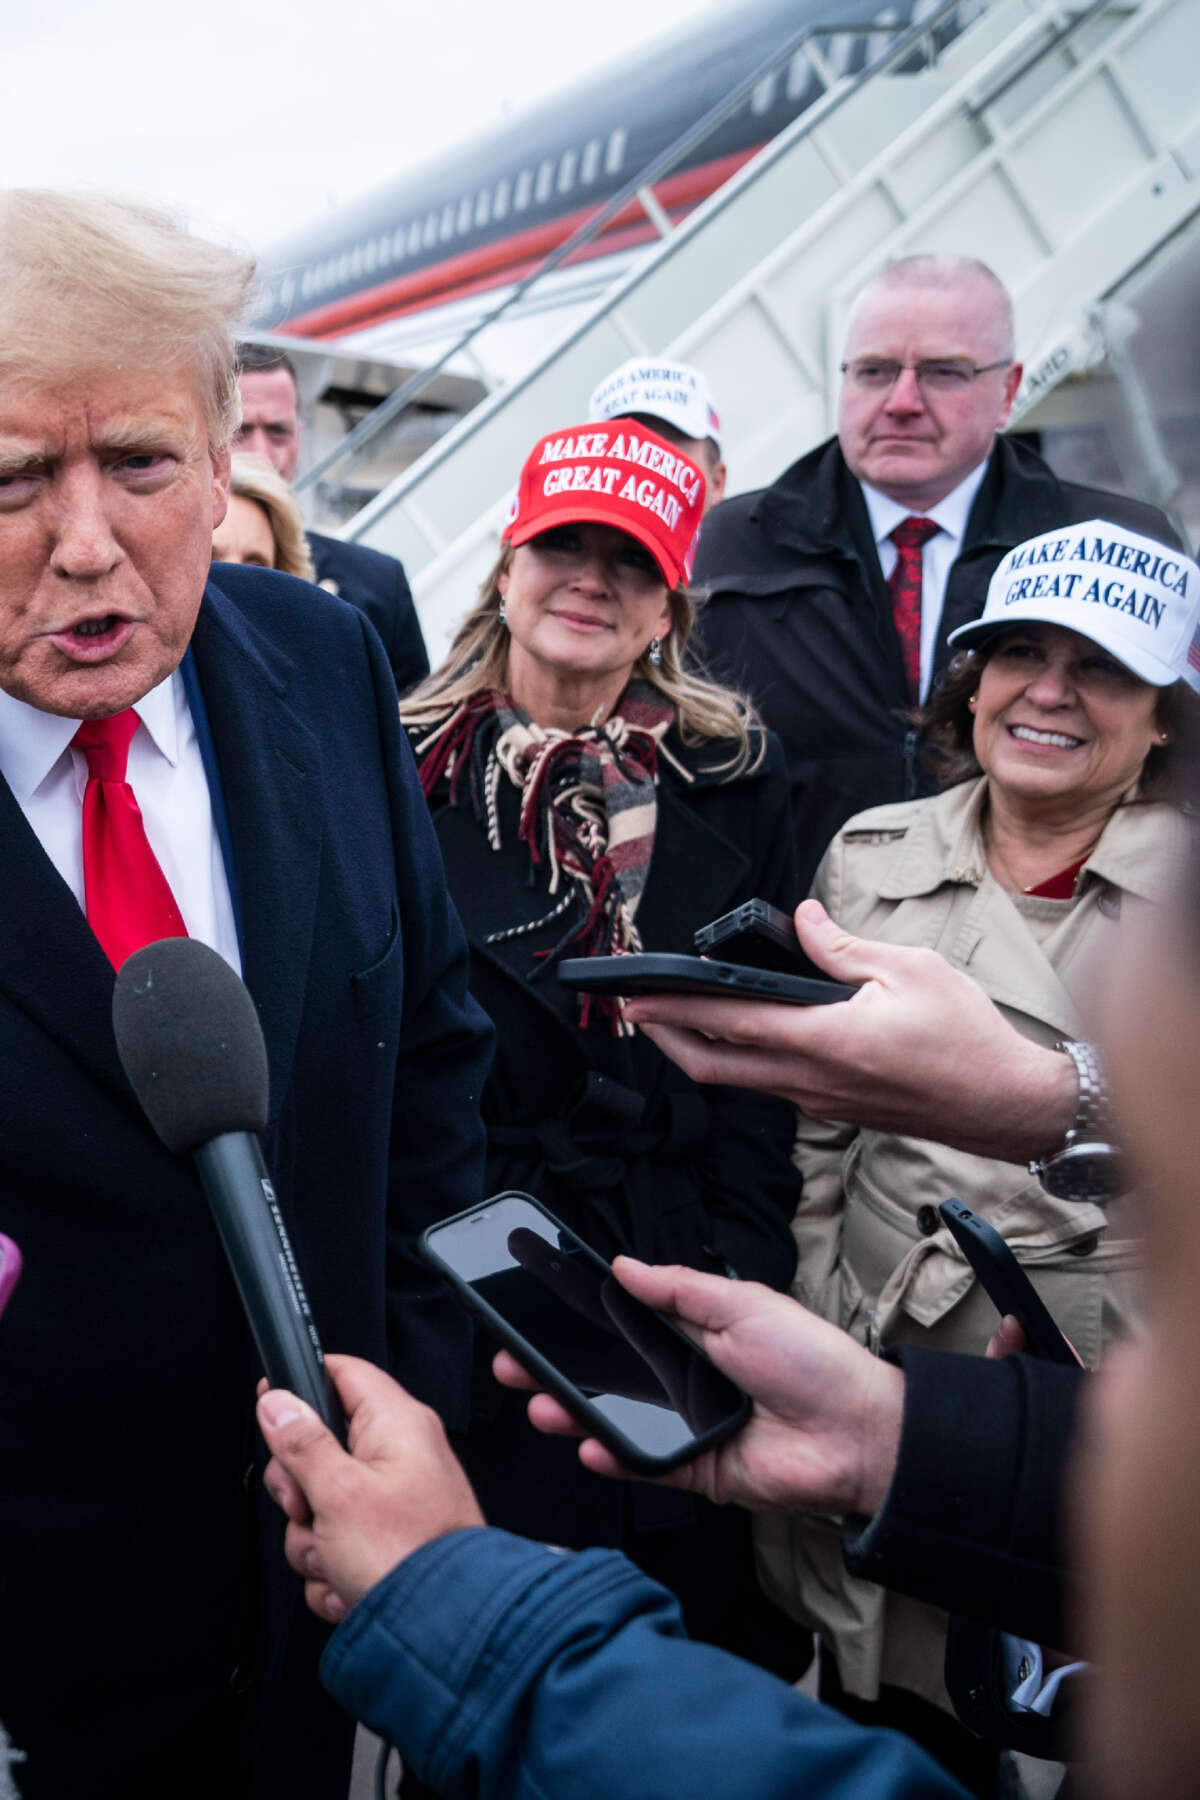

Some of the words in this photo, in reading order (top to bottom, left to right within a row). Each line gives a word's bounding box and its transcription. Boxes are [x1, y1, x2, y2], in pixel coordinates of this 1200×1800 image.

[629, 368, 696, 391] AMERICA
[539, 432, 608, 465] MAKE
[607, 433, 701, 507] AMERICA
[543, 465, 621, 497] GREAT
[618, 474, 684, 532] AGAIN
[1005, 539, 1070, 576] MAKE
[1068, 536, 1190, 599] AMERICA
[1004, 573, 1083, 606] GREAT
[1081, 577, 1167, 630] AGAIN
